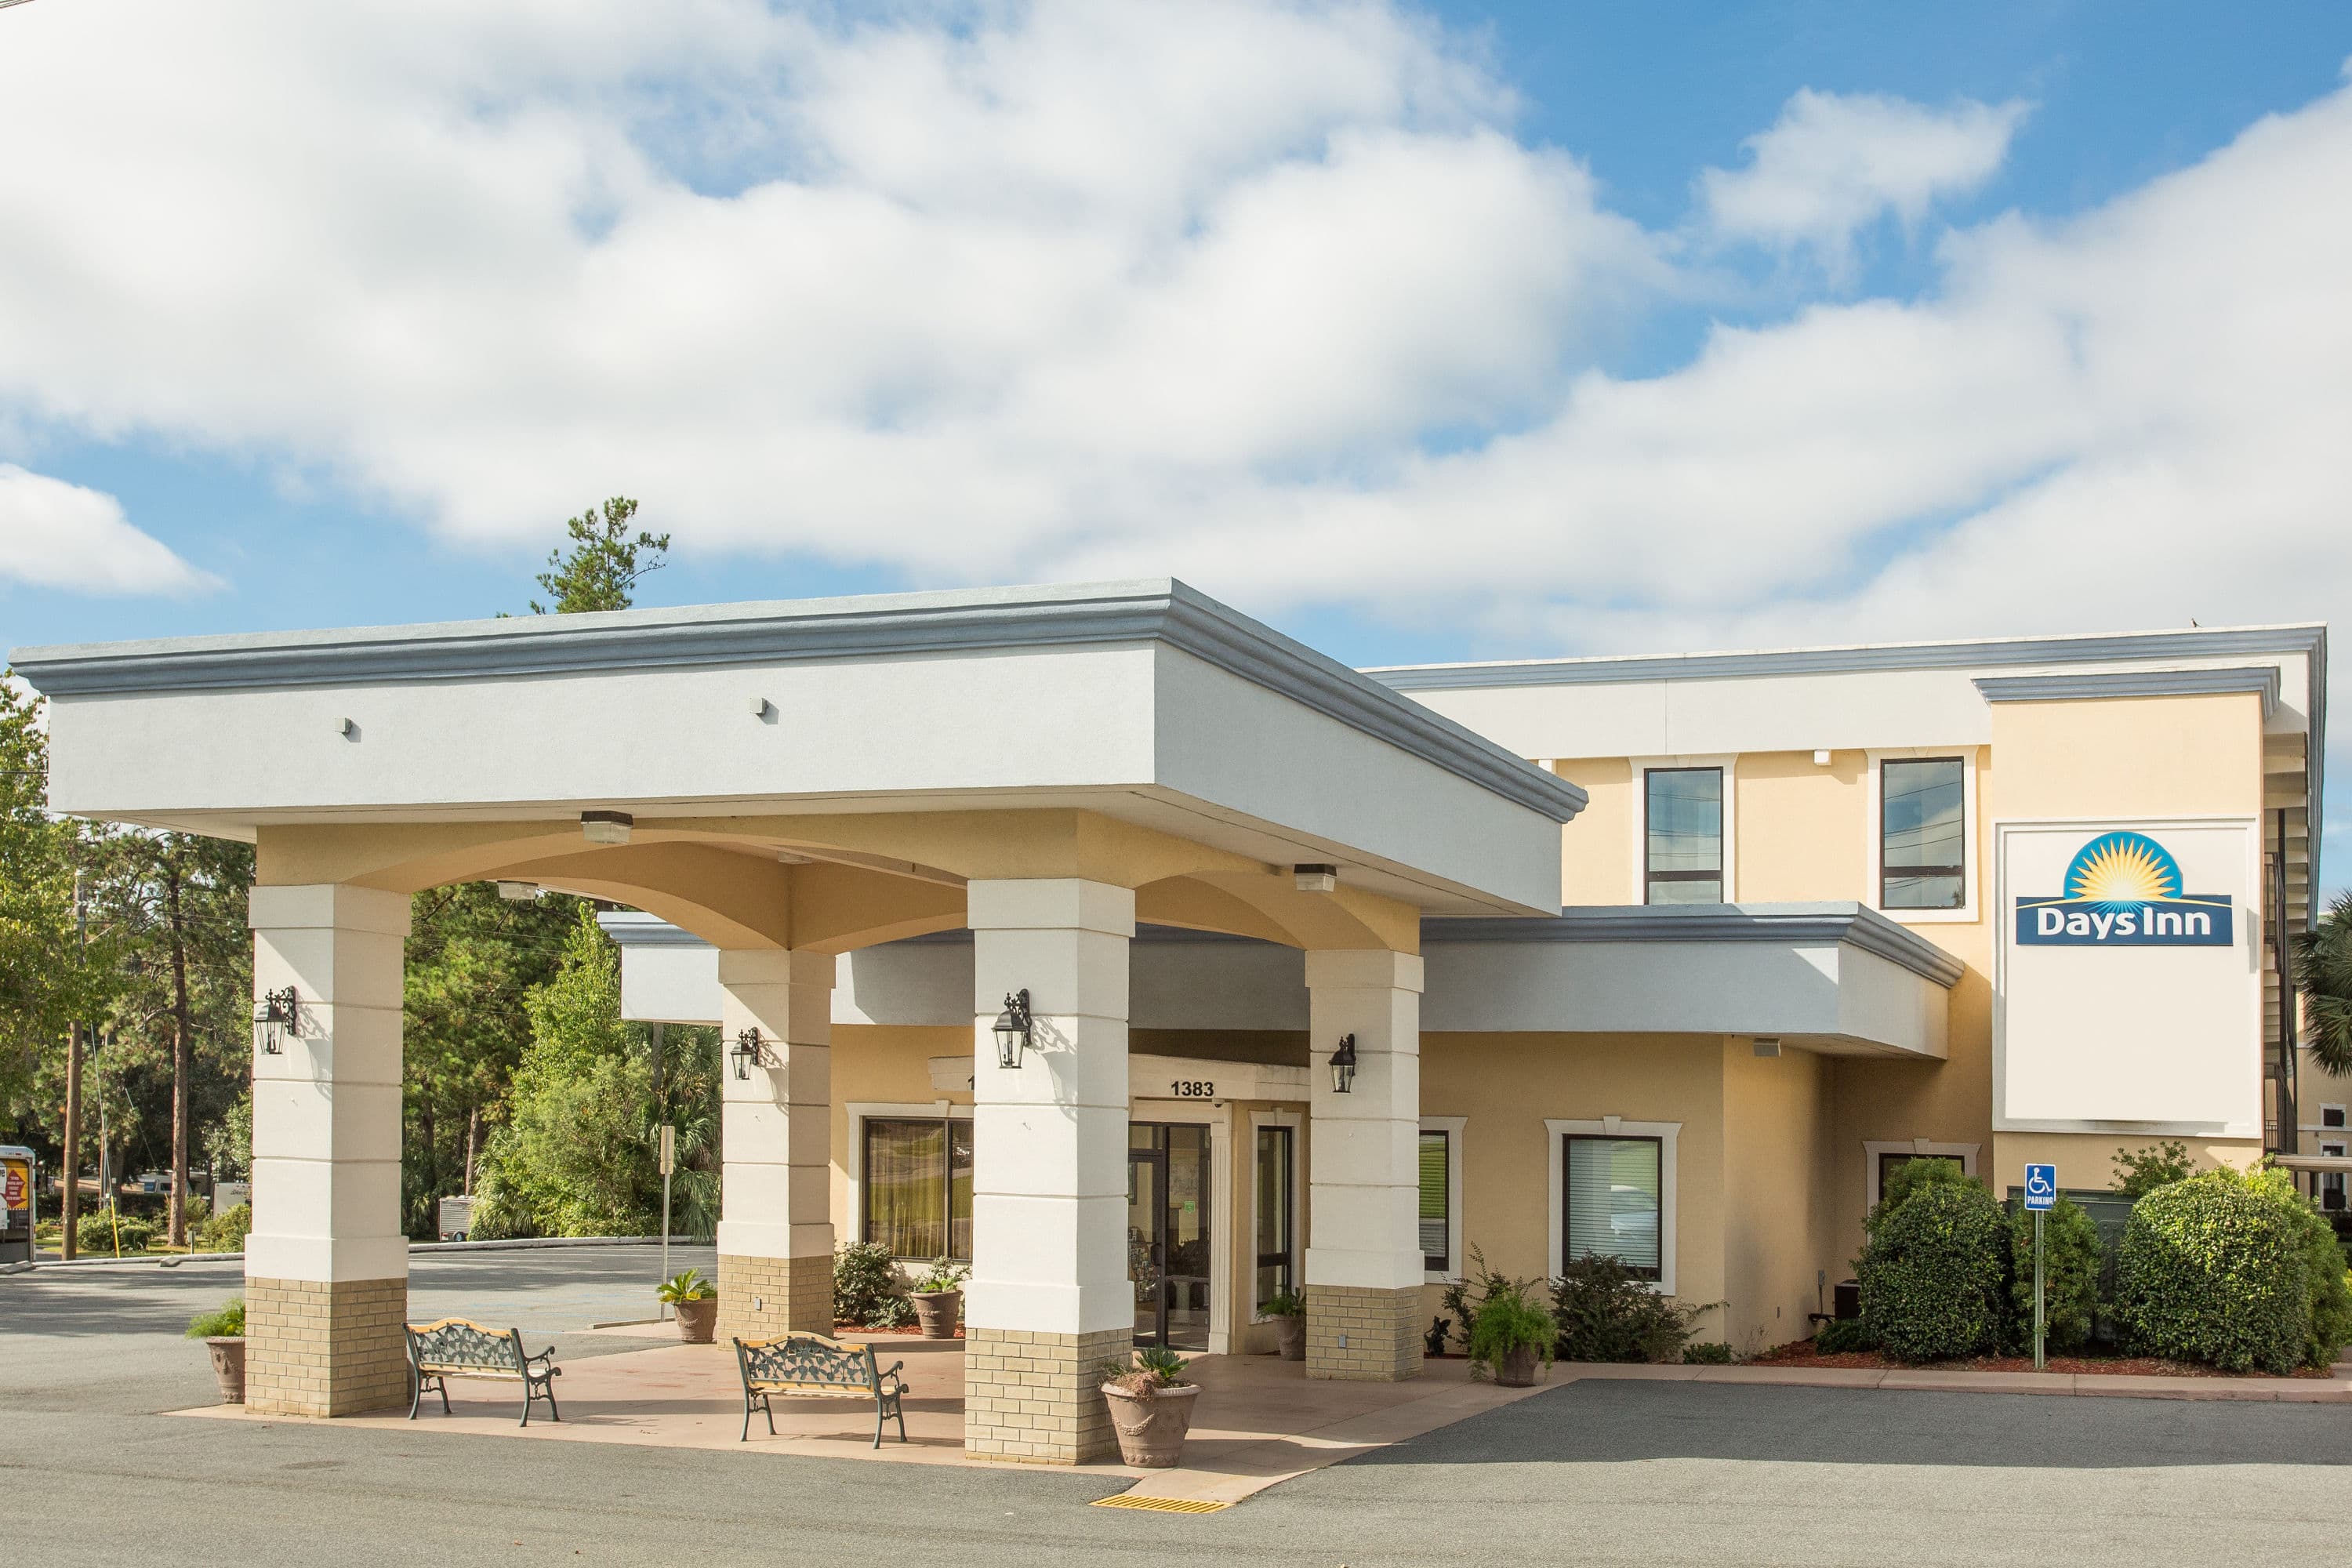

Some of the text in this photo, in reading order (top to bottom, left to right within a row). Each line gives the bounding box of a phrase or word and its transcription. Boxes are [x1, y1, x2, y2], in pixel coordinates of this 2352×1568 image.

[2038, 907, 2211, 940] Days Inn
[1171, 1081, 1214, 1097] 1383
[2027, 1196, 2054, 1205] PARKING
